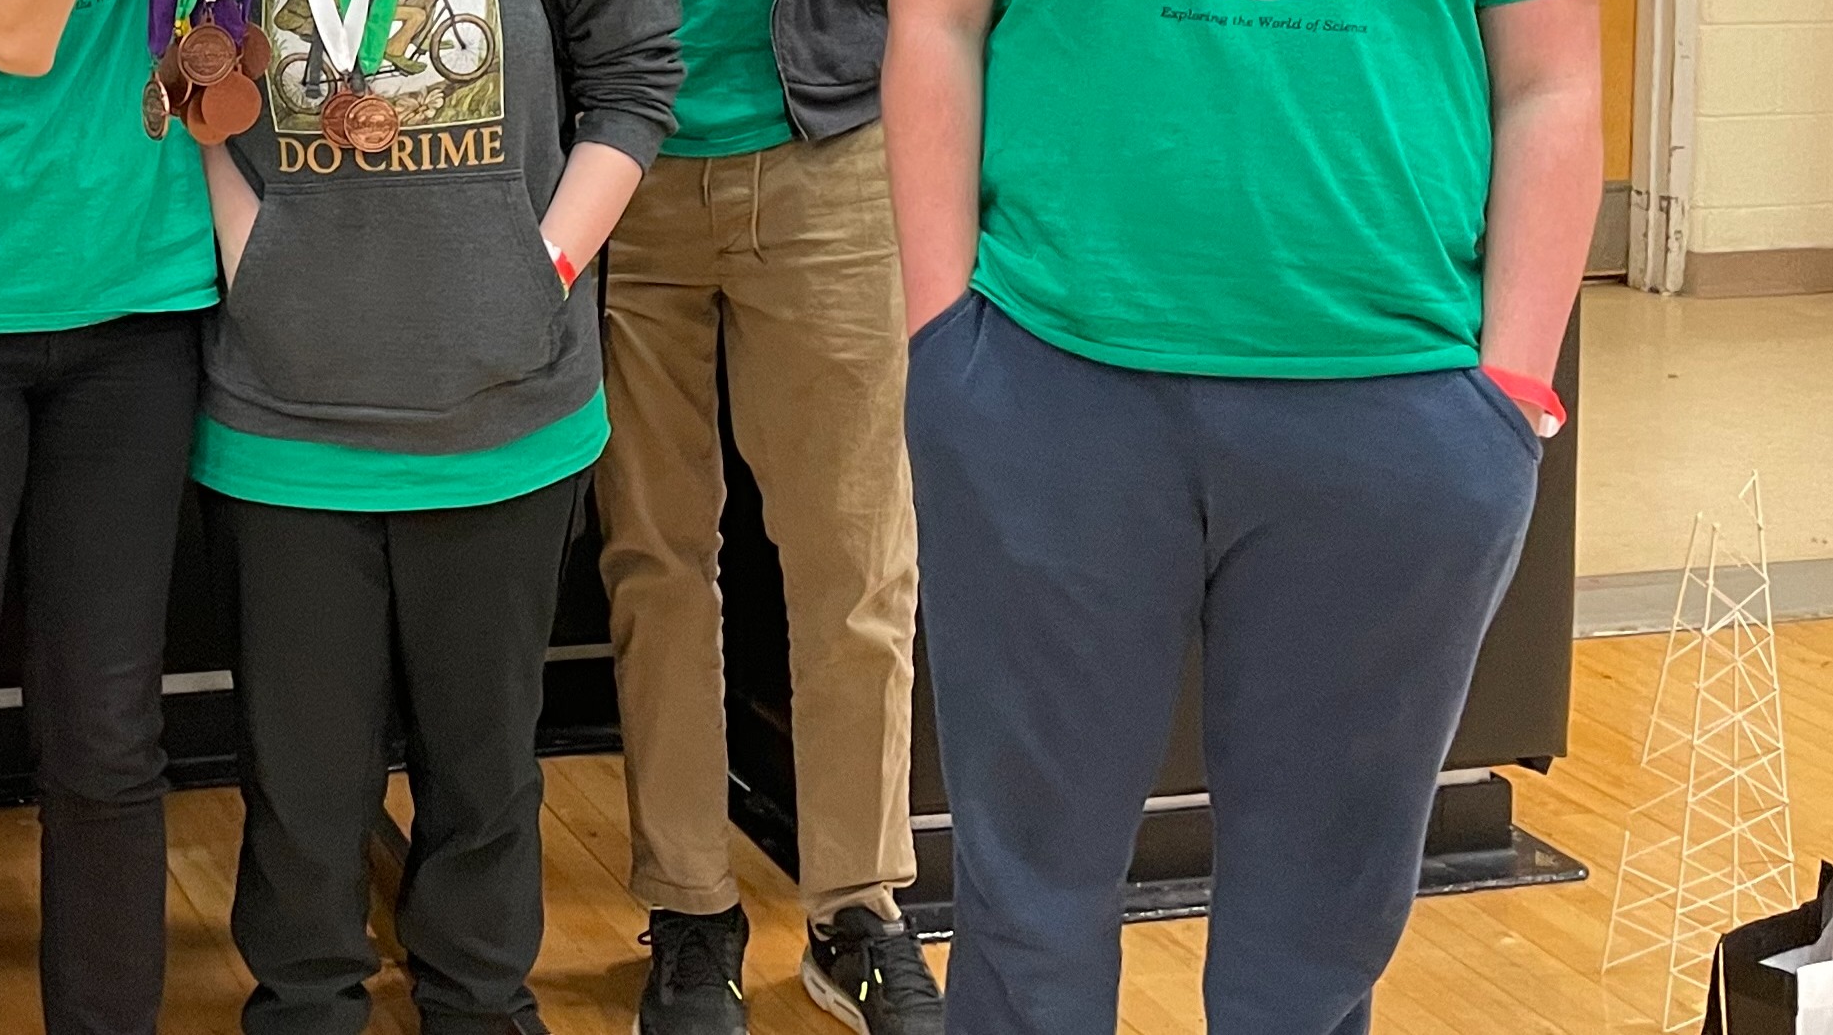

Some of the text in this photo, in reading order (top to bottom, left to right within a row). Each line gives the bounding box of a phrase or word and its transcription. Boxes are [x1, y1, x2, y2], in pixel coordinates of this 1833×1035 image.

[1160, 6, 1228, 26] Exploring
[1232, 15, 1253, 27] the
[1258, 16, 1301, 30] World
[1306, 19, 1320, 32] of
[277, 125, 506, 174] DO CRIME
